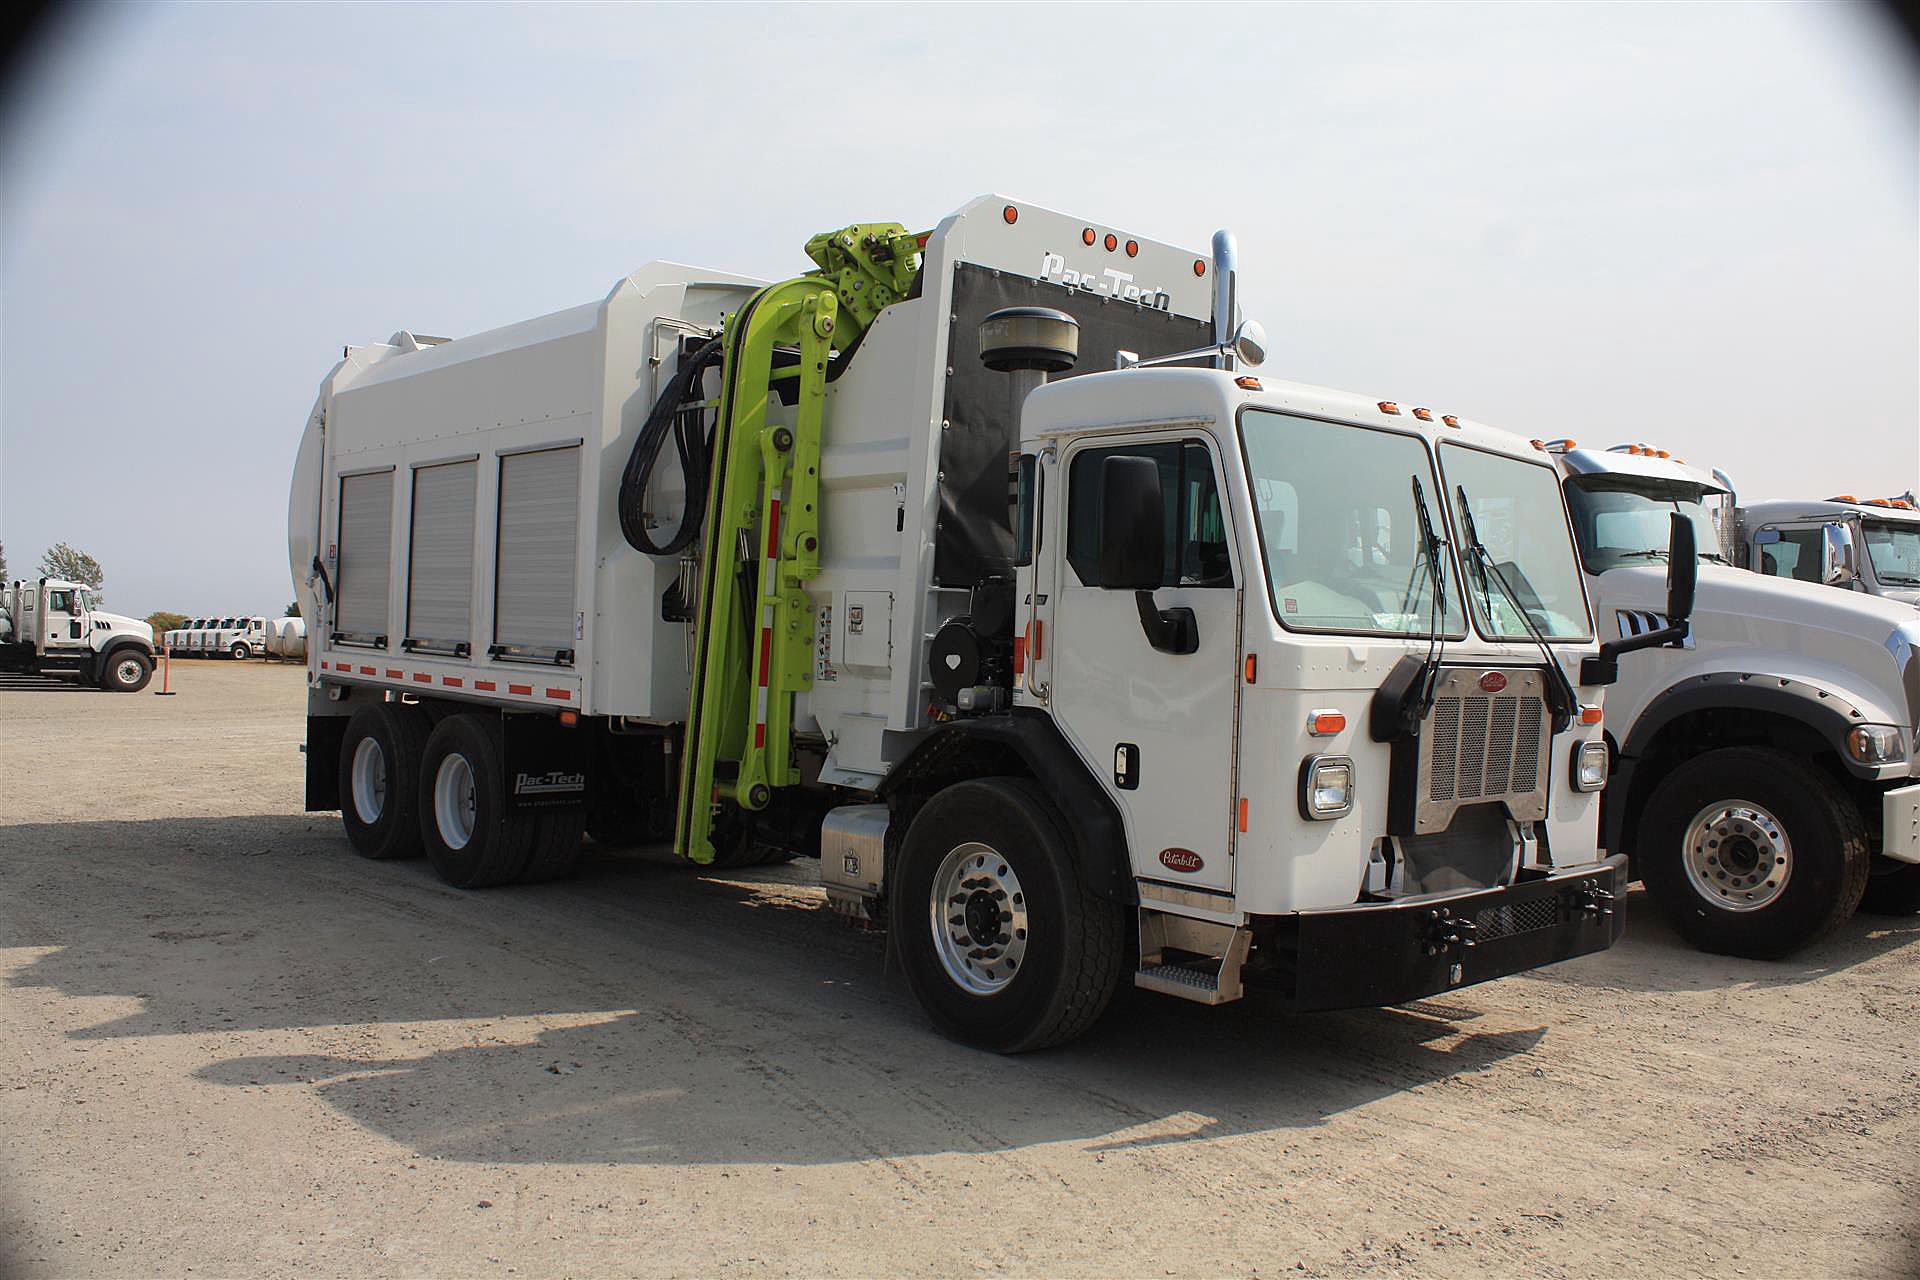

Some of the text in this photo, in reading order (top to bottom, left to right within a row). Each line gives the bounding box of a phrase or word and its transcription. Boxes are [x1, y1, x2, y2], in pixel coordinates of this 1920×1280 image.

[1039, 251, 1171, 311] Pac-Tech
[514, 771, 585, 794] Pac-Tech
[1163, 850, 1200, 867] Peterbilt
